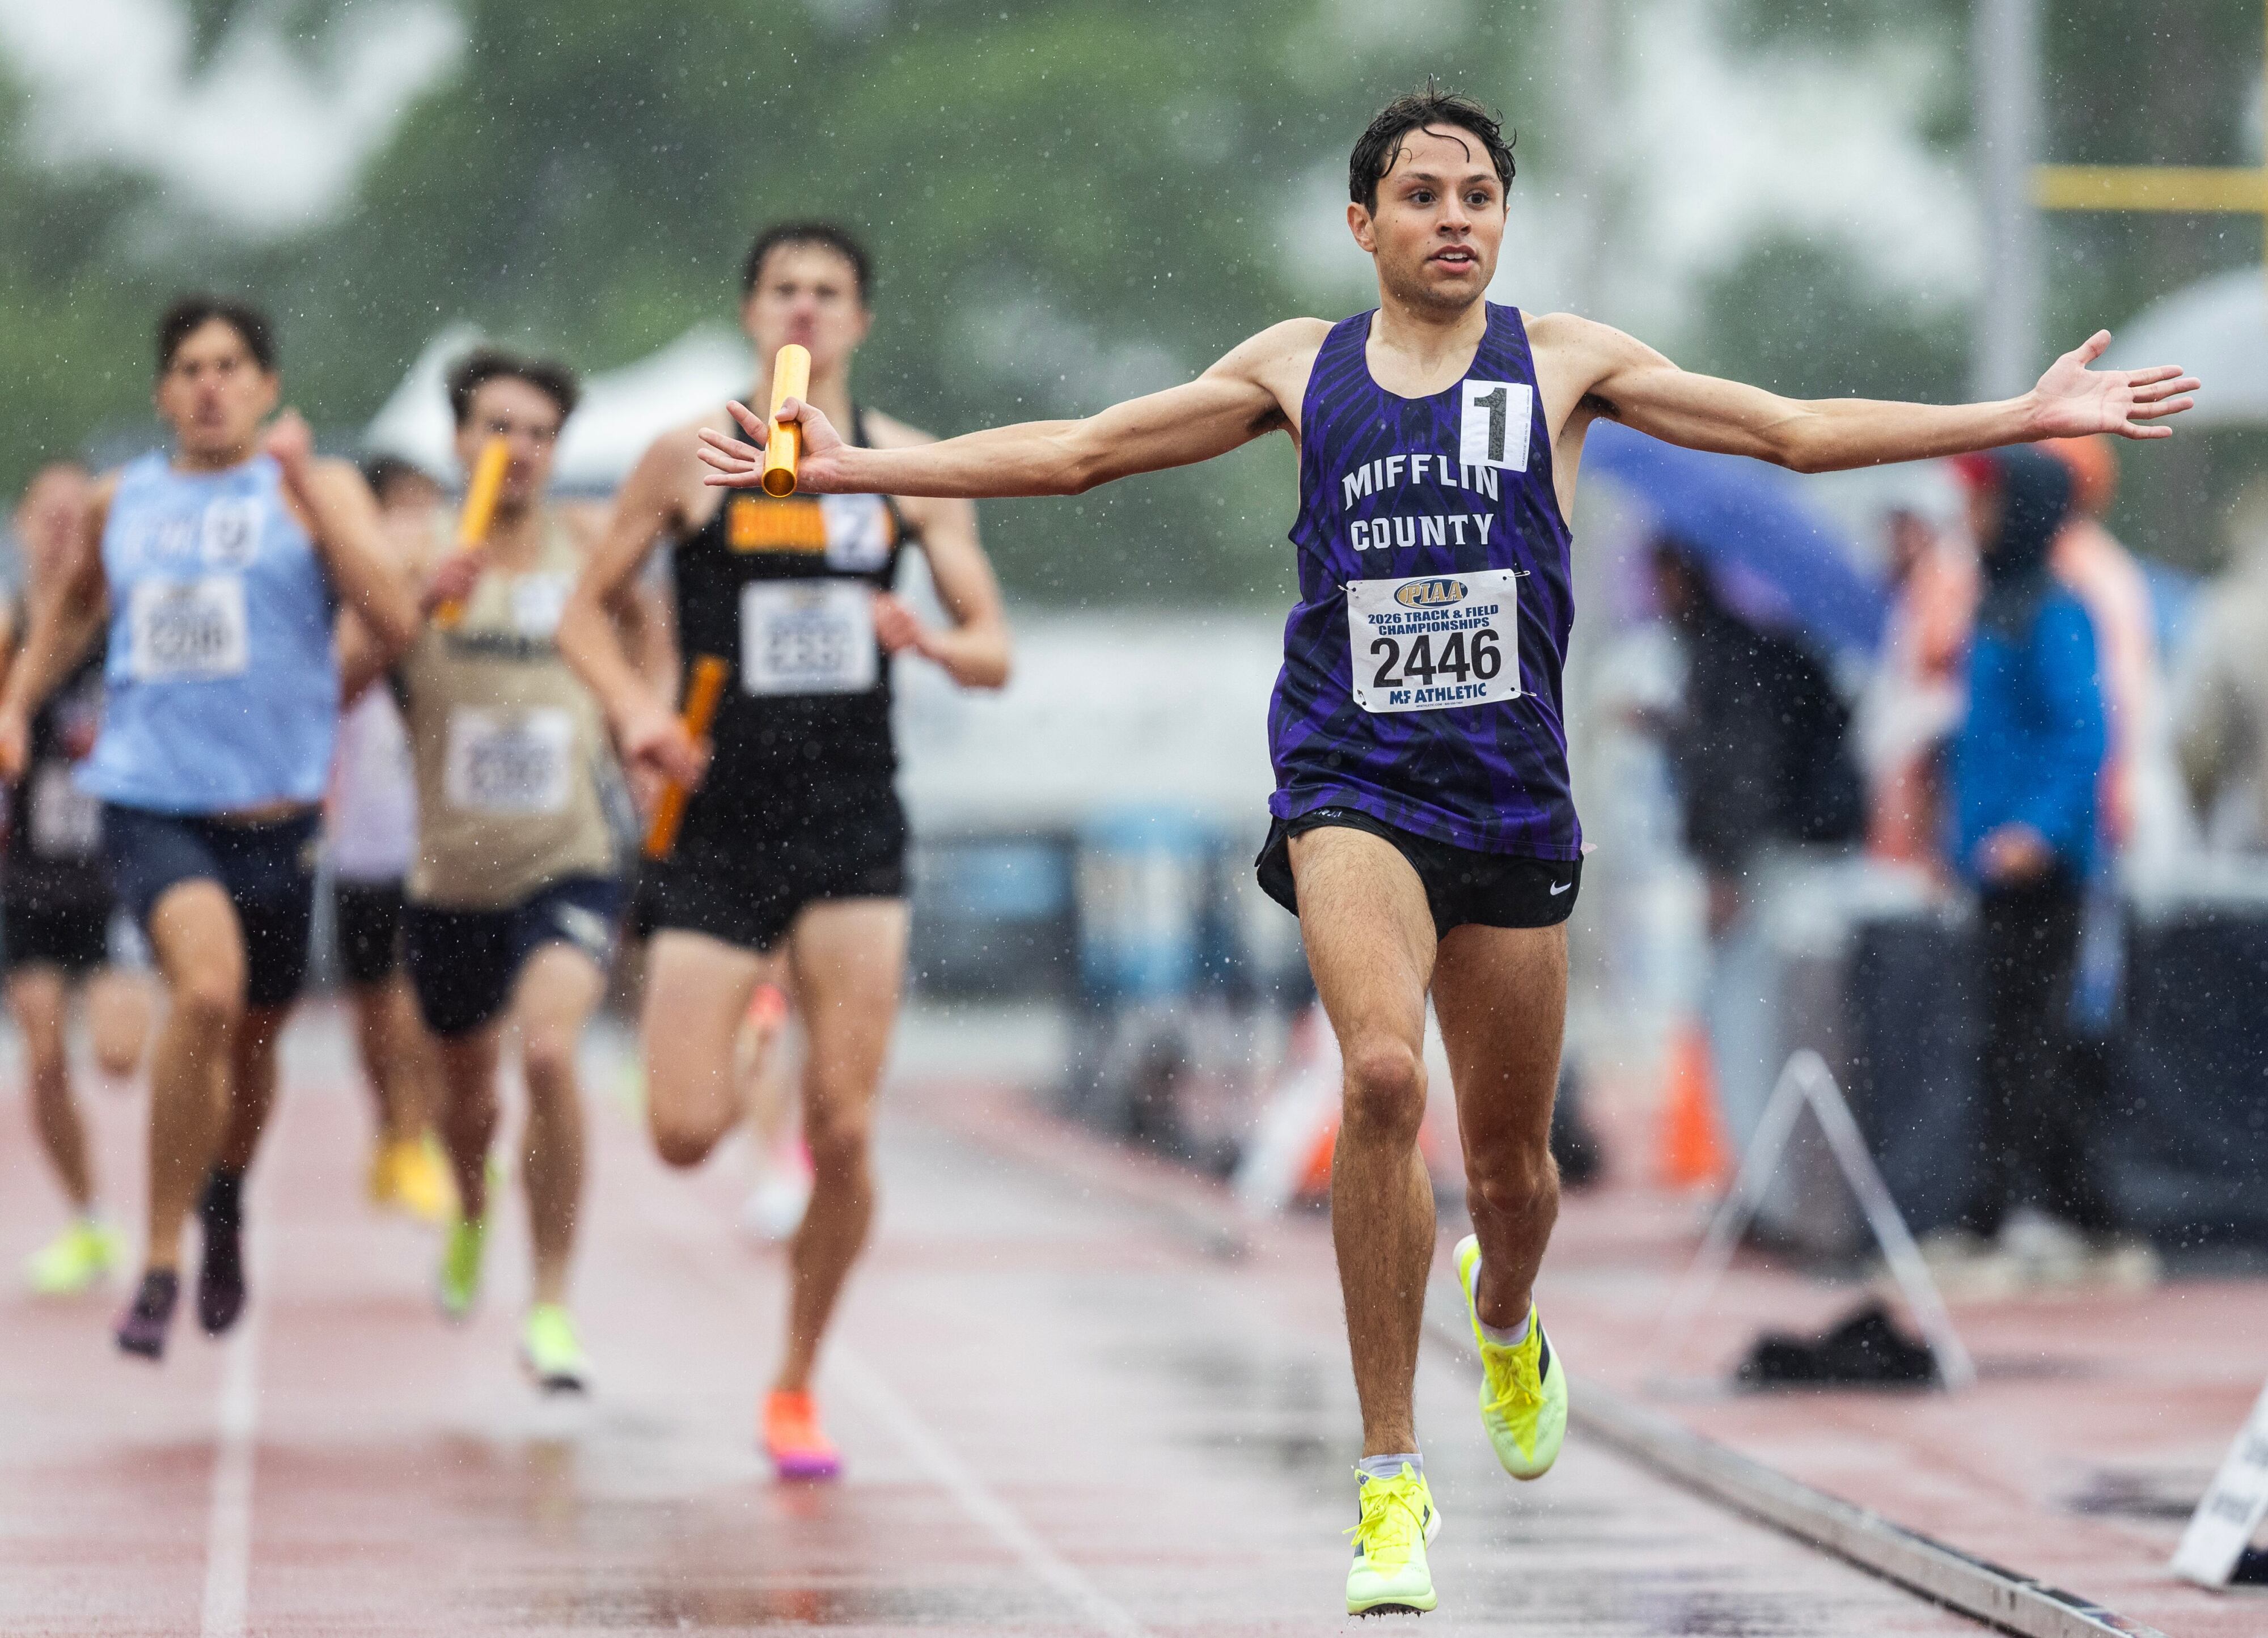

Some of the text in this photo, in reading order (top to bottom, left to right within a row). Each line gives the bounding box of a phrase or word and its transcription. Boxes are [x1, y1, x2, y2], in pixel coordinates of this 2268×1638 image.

[1474, 387, 1507, 462] 1
[1342, 454, 1499, 511] MIFFLIN
[1351, 513, 1495, 551] COUNTY
[1405, 581, 1464, 604] PIAA
[1368, 604, 1499, 624] 2026 TRACK & FIELD
[1378, 617, 1490, 636] CHAMPIONSHIPS
[1370, 629, 1501, 688] 2446
[1414, 682, 1487, 703] ATHLETIC
